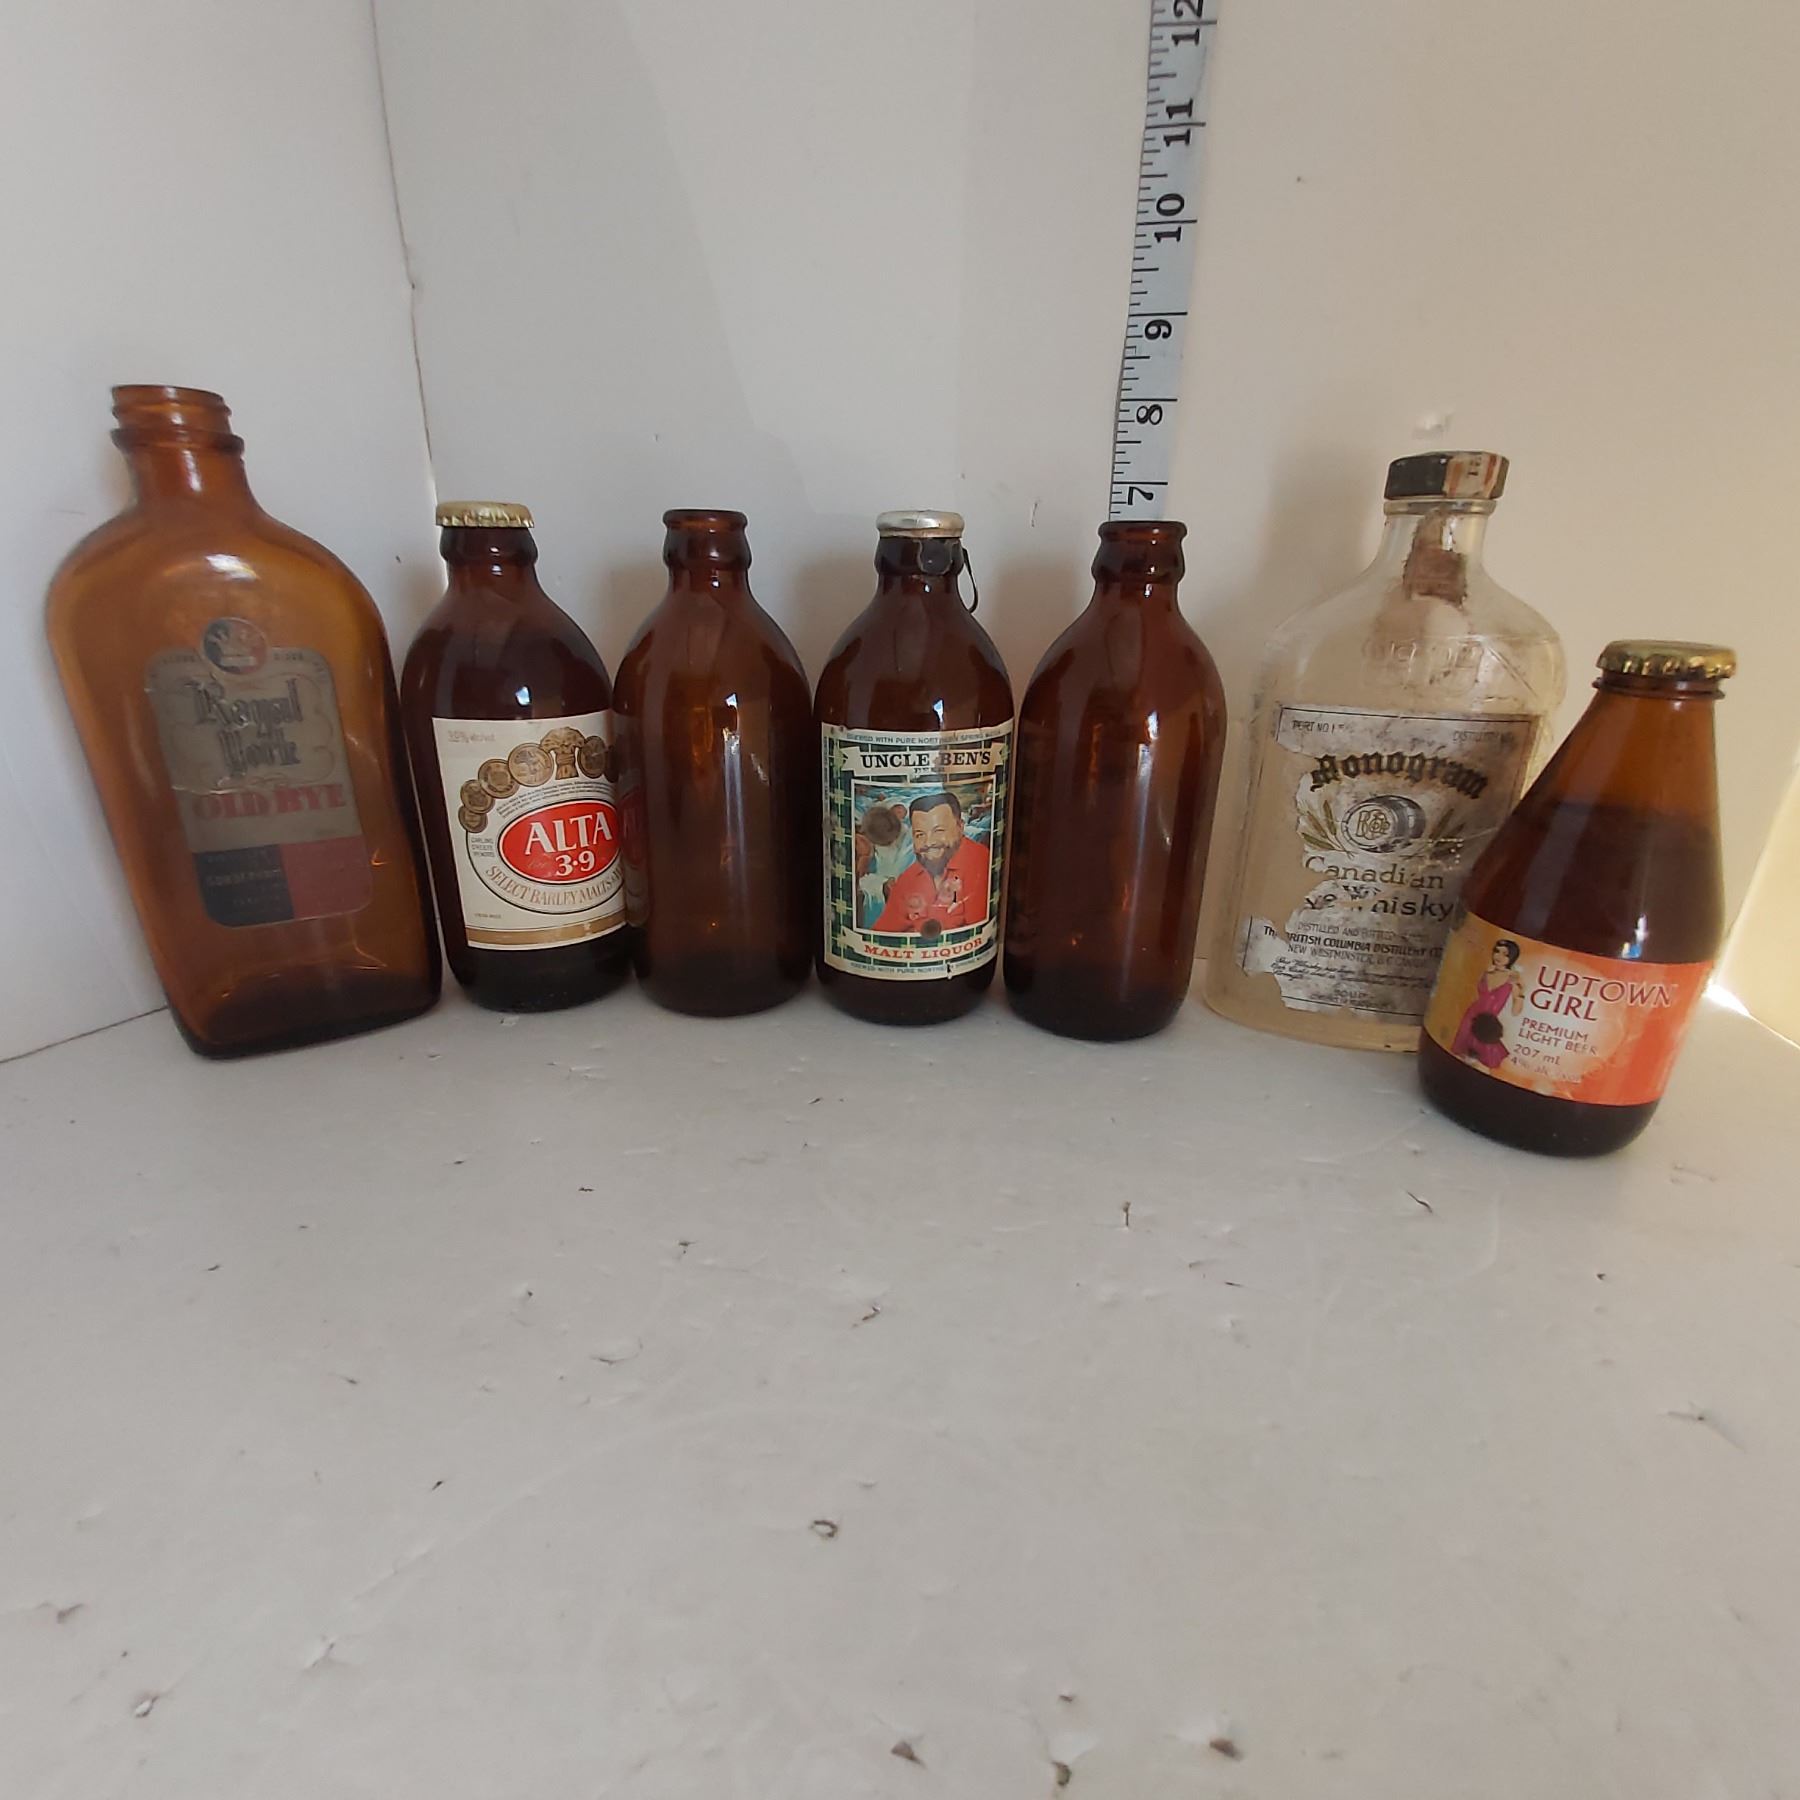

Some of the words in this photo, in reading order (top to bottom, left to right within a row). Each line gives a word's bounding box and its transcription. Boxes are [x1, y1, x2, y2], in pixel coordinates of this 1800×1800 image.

[1163, 98, 1194, 147] 11
[1153, 193, 1185, 243] 10
[1144, 318, 1172, 341] 9
[1136, 403, 1163, 426] 8
[1127, 486, 1154, 506] 7
[875, 735, 894, 744] WITH
[860, 753, 930, 769] UNCLE
[939, 750, 991, 766] BEN'S
[525, 811, 613, 855] ALTA
[1305, 856, 1445, 890] Canadian
[485, 865, 531, 900] SELECT
[530, 888, 578, 906] BARLEY
[863, 944, 915, 959] MALT
[921, 937, 982, 960] LIQUOR
[1287, 943, 1307, 954] NEW
[1323, 937, 1370, 953] COLUMBIA
[1537, 965, 1673, 1008] UPTOWN
[1530, 989, 1599, 1022] GIRL
[1518, 1030, 1562, 1048] LIGHT
[1522, 1017, 1589, 1042] PREMIUM
[1513, 1043, 1540, 1058] 207
